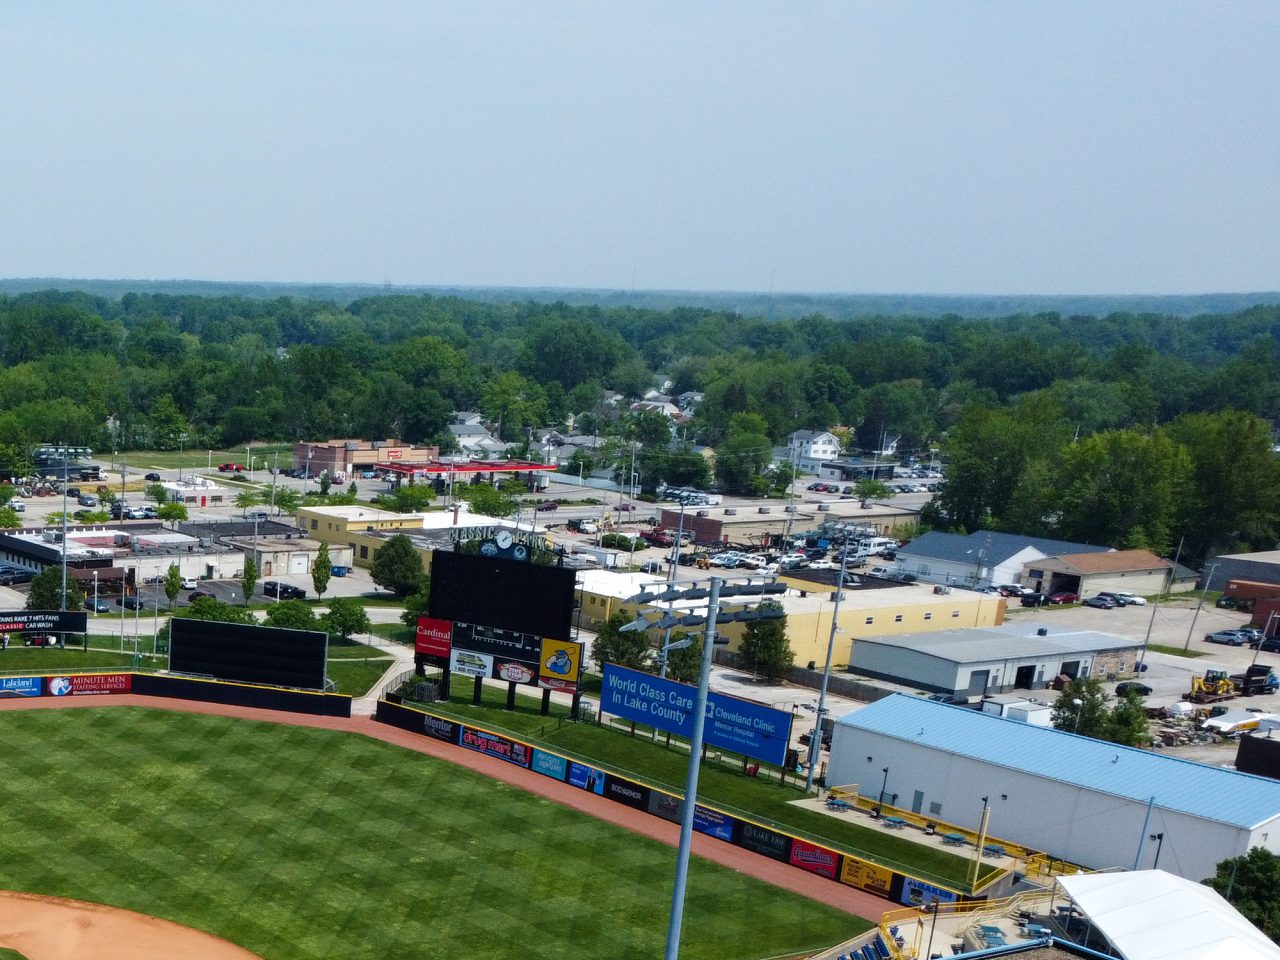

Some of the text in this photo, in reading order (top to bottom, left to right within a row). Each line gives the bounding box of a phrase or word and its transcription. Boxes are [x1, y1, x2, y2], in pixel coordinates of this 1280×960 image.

[448, 526, 495, 542] CLASSIC
[416, 625, 451, 639] Cardinal
[3, 678, 33, 687] Lakeland
[73, 675, 126, 685] MINUTE MEN
[609, 674, 693, 710] World Class Care
[612, 691, 686, 725] In Lake County
[424, 715, 453, 732] Mentor
[715, 707, 775, 733] Cleveland Clinic
[463, 731, 488, 750] drug
[488, 740, 512, 756] mart
